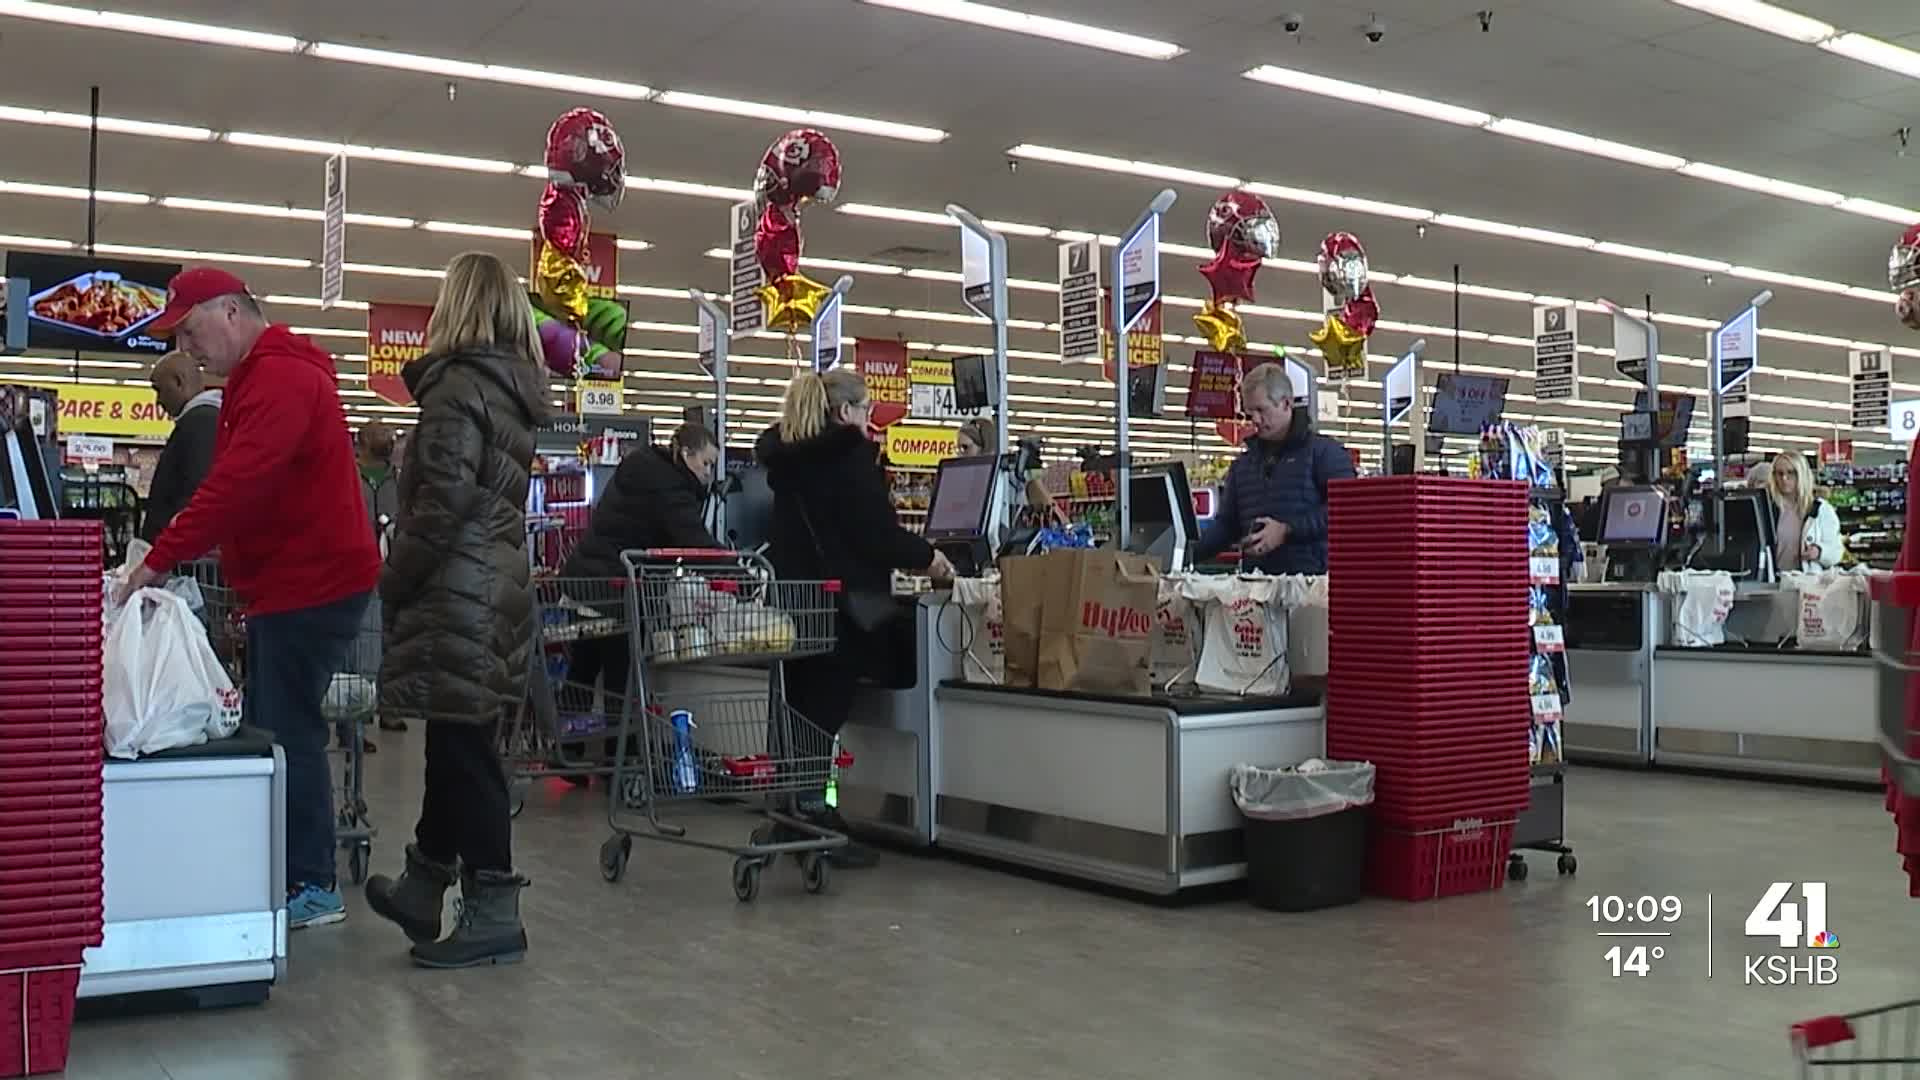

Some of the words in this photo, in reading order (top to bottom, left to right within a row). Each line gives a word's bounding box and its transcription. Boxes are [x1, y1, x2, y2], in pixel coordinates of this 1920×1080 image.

[740, 209, 750, 231] 6
[1072, 248, 1083, 268] 7
[1548, 311, 1559, 328] 9
[381, 329, 425, 345] NEW
[1106, 331, 1160, 349] LWER
[371, 344, 431, 360] LOWE
[1106, 349, 1160, 364] PICES
[864, 361, 899, 374] NEW
[1863, 354, 1877, 368] 11
[912, 366, 953, 378] COMPAR
[864, 374, 906, 389] OWER
[866, 388, 906, 402] RICES
[56, 399, 105, 419] PARE
[109, 402, 123, 420] &
[130, 403, 171, 421] SAV
[1903, 410, 1915, 430] 8
[892, 438, 956, 456] COMPARE
